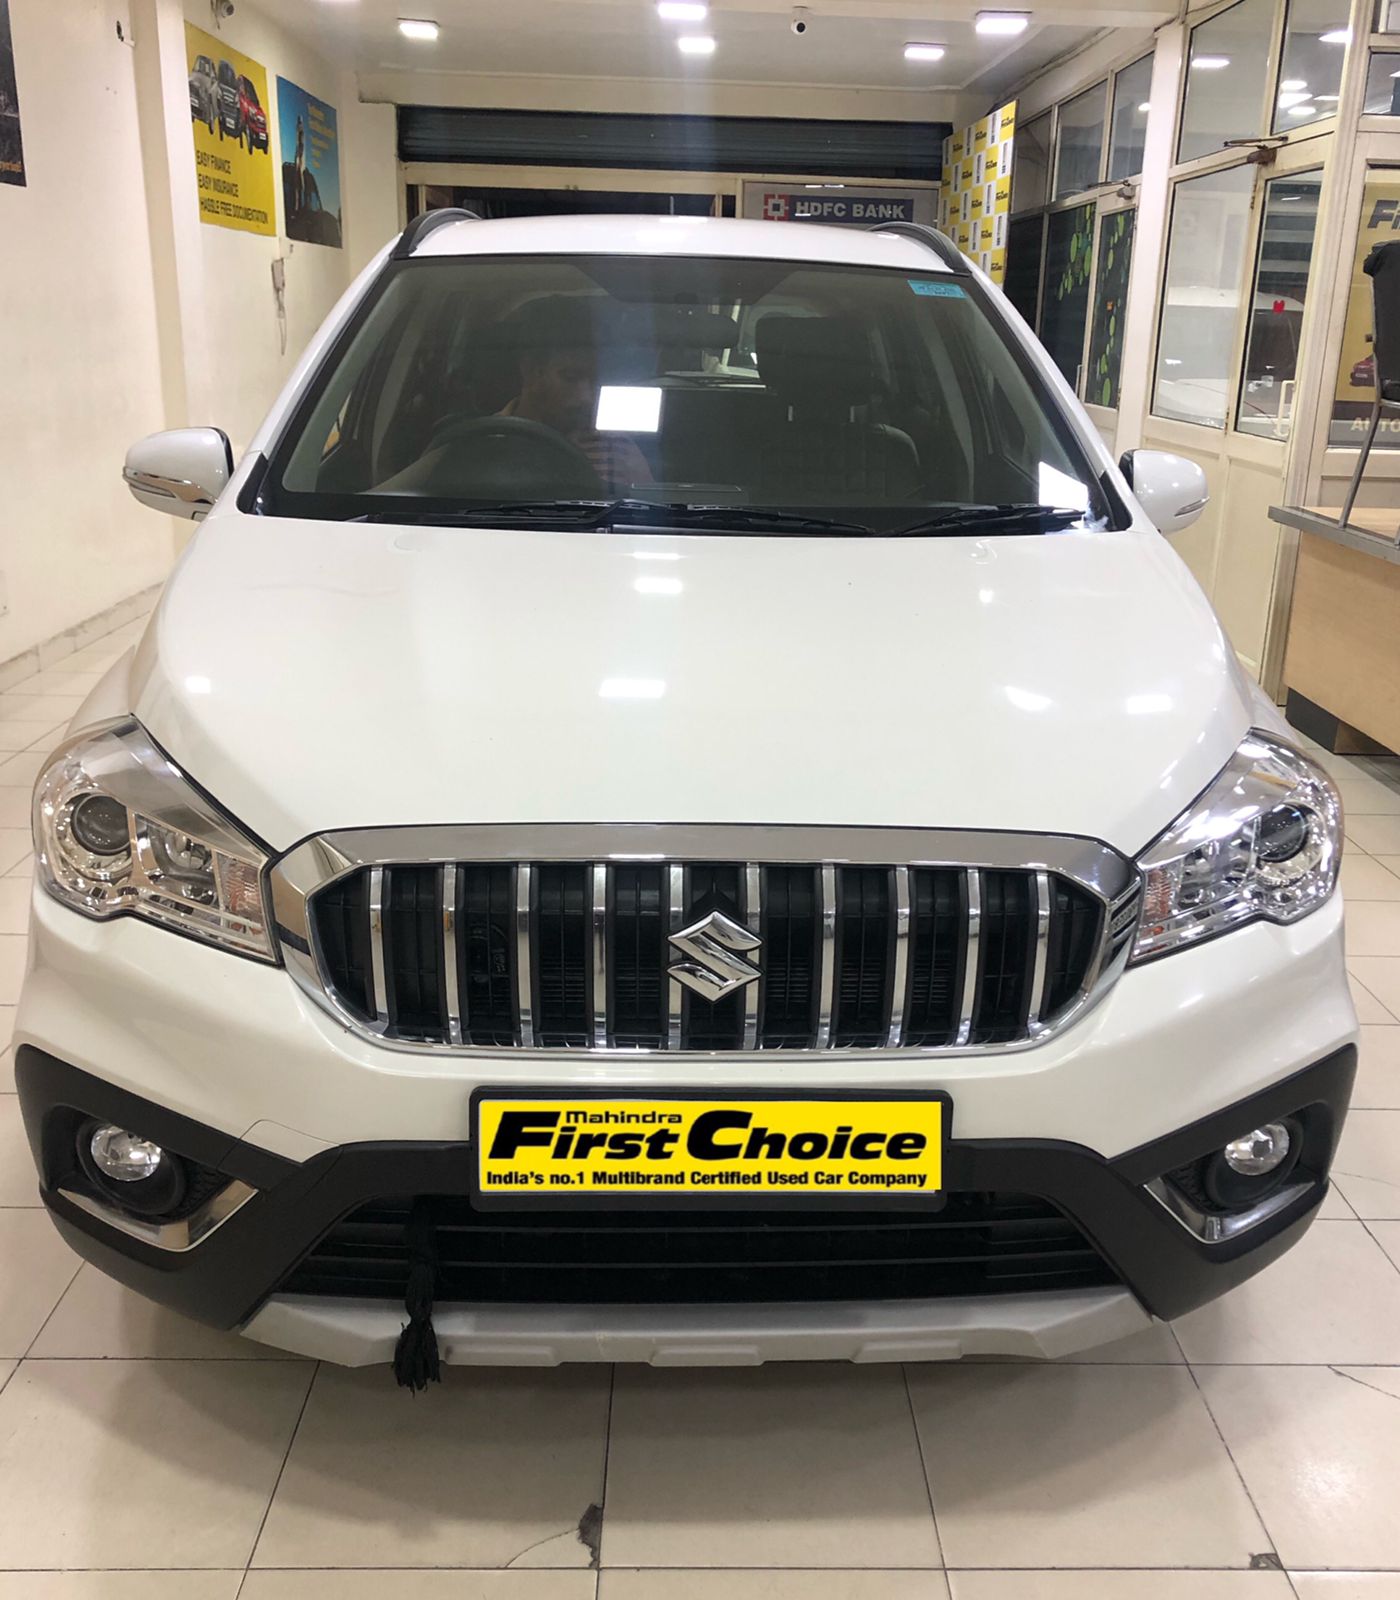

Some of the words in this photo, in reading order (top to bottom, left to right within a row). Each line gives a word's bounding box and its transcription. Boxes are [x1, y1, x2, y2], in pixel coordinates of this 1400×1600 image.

[795, 202, 847, 217] HDFC
[852, 203, 905, 219] BANK
[566, 1111, 682, 1123] Mahindra
[488, 1111, 680, 1160] First
[686, 1110, 927, 1160] Choice
[487, 1171, 544, 1185] India's
[550, 1171, 585, 1185] no.1
[592, 1171, 685, 1185] Multibrand
[690, 1171, 762, 1185] Certified
[767, 1171, 809, 1185] Used
[814, 1171, 843, 1185] Car
[848, 1171, 927, 1187] Company
